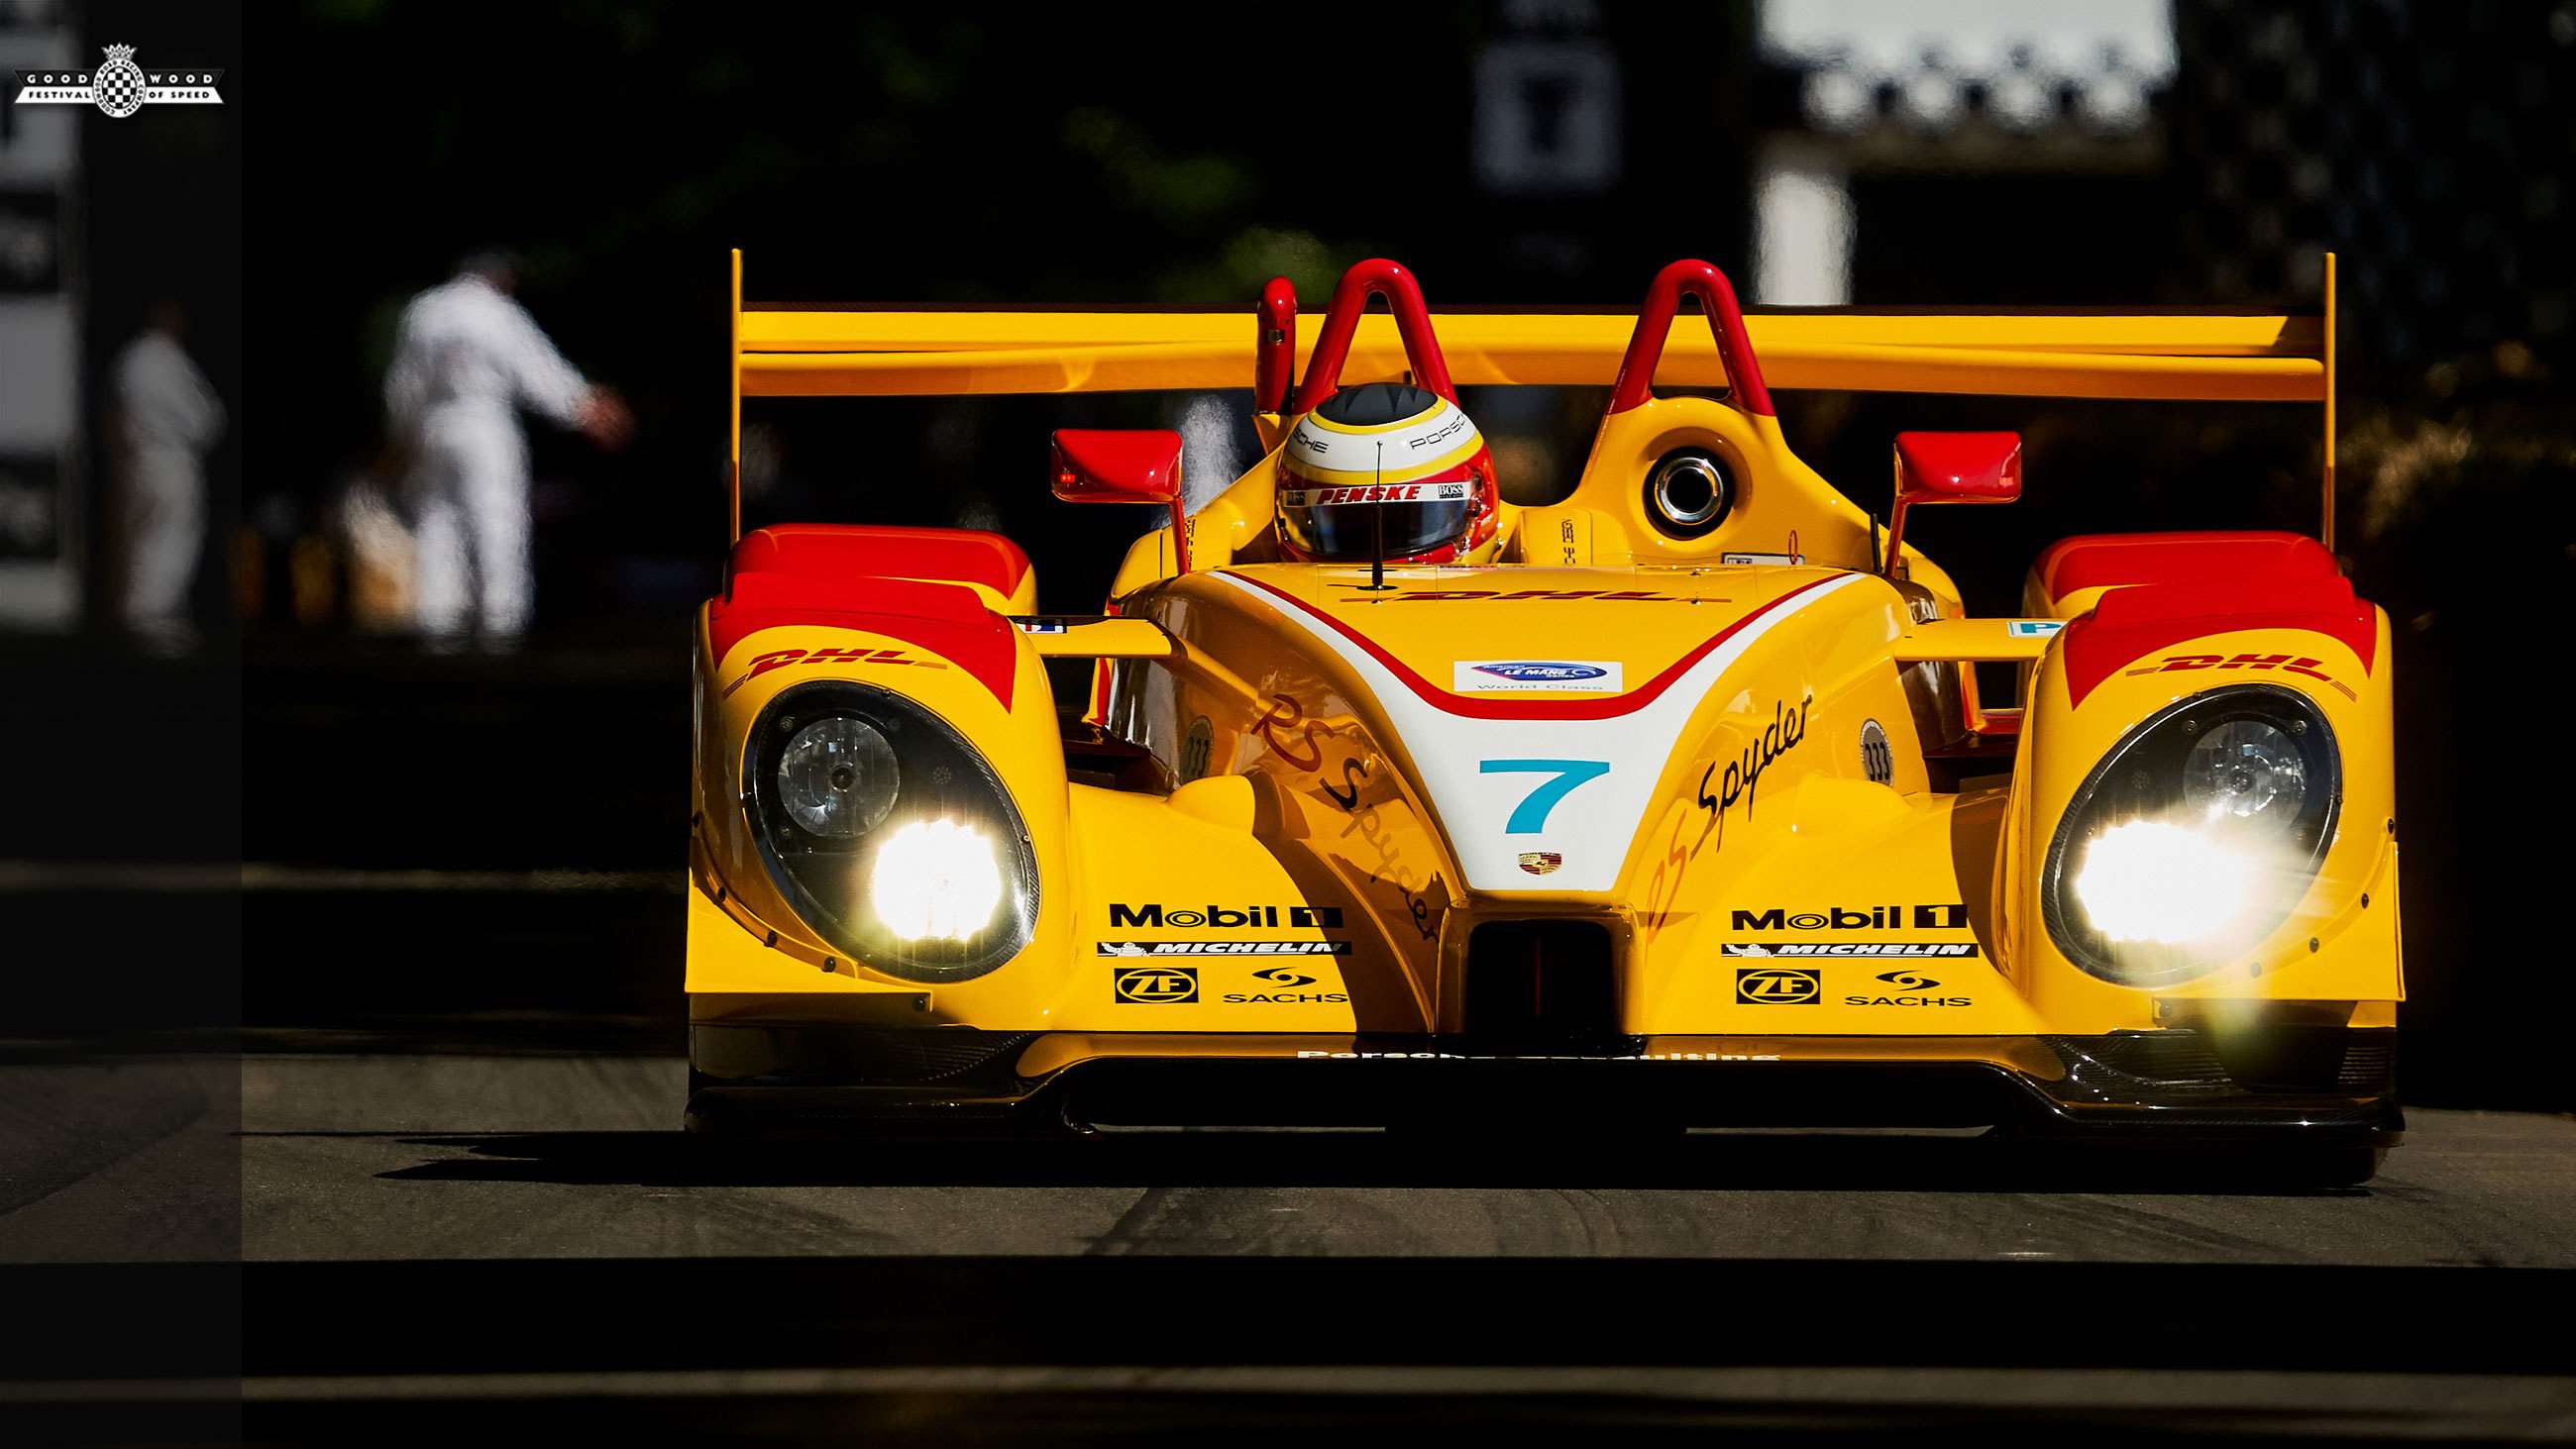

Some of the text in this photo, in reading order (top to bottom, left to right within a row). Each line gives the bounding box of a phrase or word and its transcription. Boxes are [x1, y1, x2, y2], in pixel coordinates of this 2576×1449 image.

[1317, 485, 1421, 505] PENSKE
[1438, 484, 1464, 495] BOSS
[1392, 590, 1675, 601] DHL
[747, 649, 913, 680] DHL
[2159, 654, 2332, 682] DHL
[1250, 693, 1336, 773] RS
[1690, 694, 1813, 862] Spyder
[1479, 759, 1610, 834] 7
[1109, 903, 1278, 928] Mobil
[1732, 905, 1901, 930] Mobil
[1152, 942, 1343, 954] MICHELIN
[1776, 944, 1971, 955] MICHELIN
[1223, 993, 1348, 1003] SACHS
[1845, 996, 1973, 1006] SACHS
